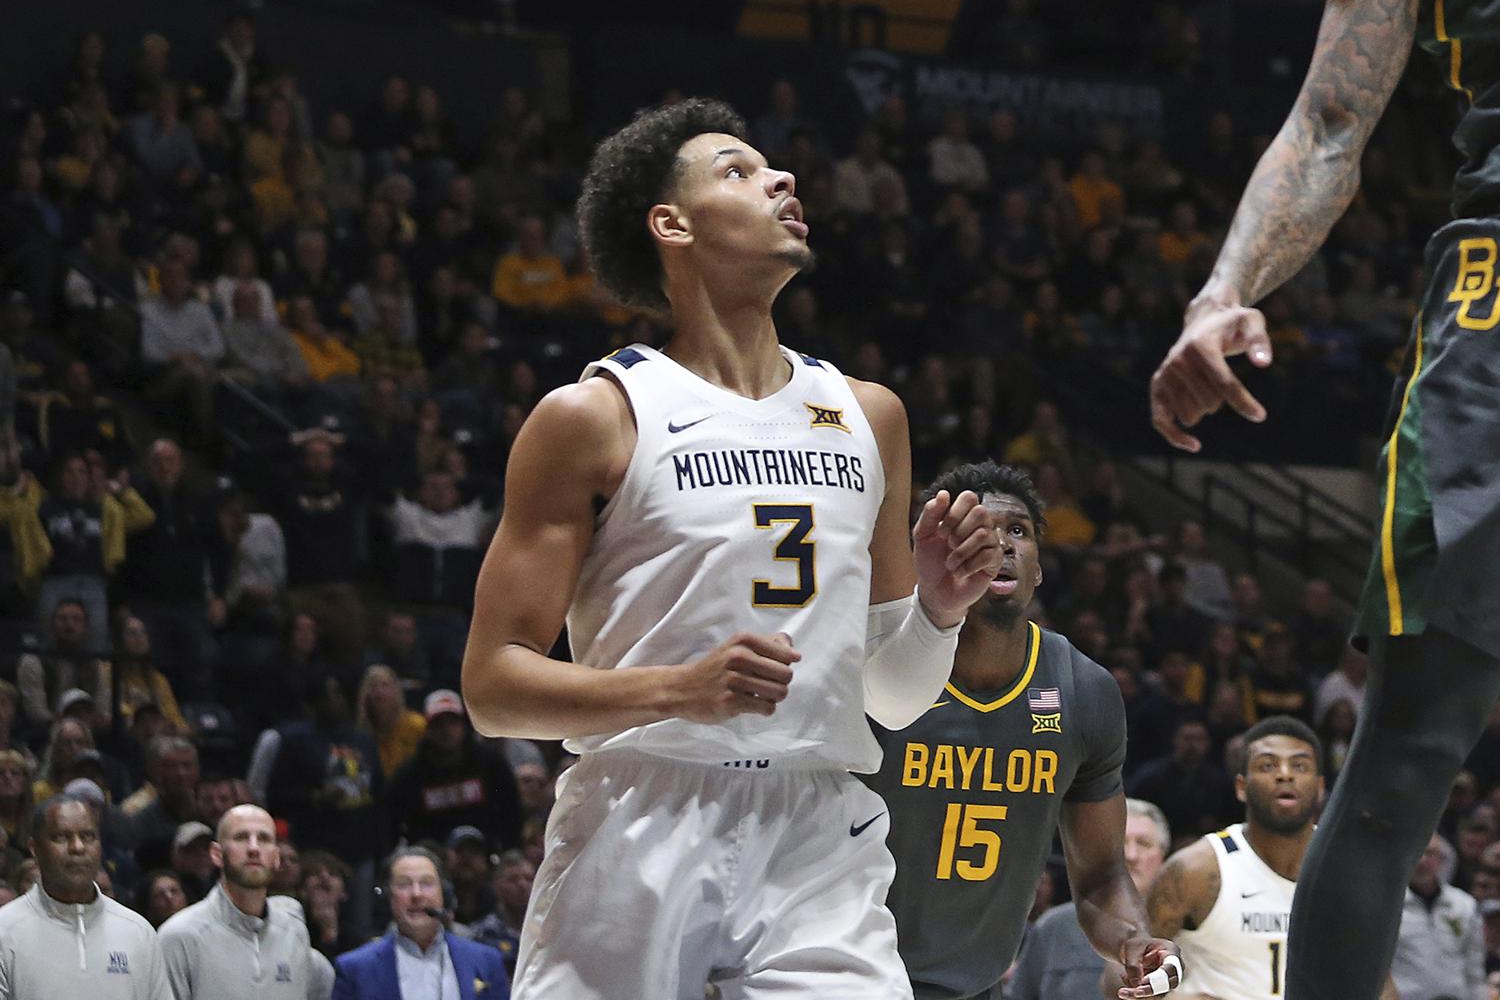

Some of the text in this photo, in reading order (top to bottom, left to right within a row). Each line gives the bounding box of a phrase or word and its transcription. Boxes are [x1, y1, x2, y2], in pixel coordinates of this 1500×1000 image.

[672, 449, 865, 494] MOUNTAINEERS
[751, 502, 819, 609] 3
[902, 742, 1060, 794] BAYLOR
[936, 802, 1009, 881] 15
